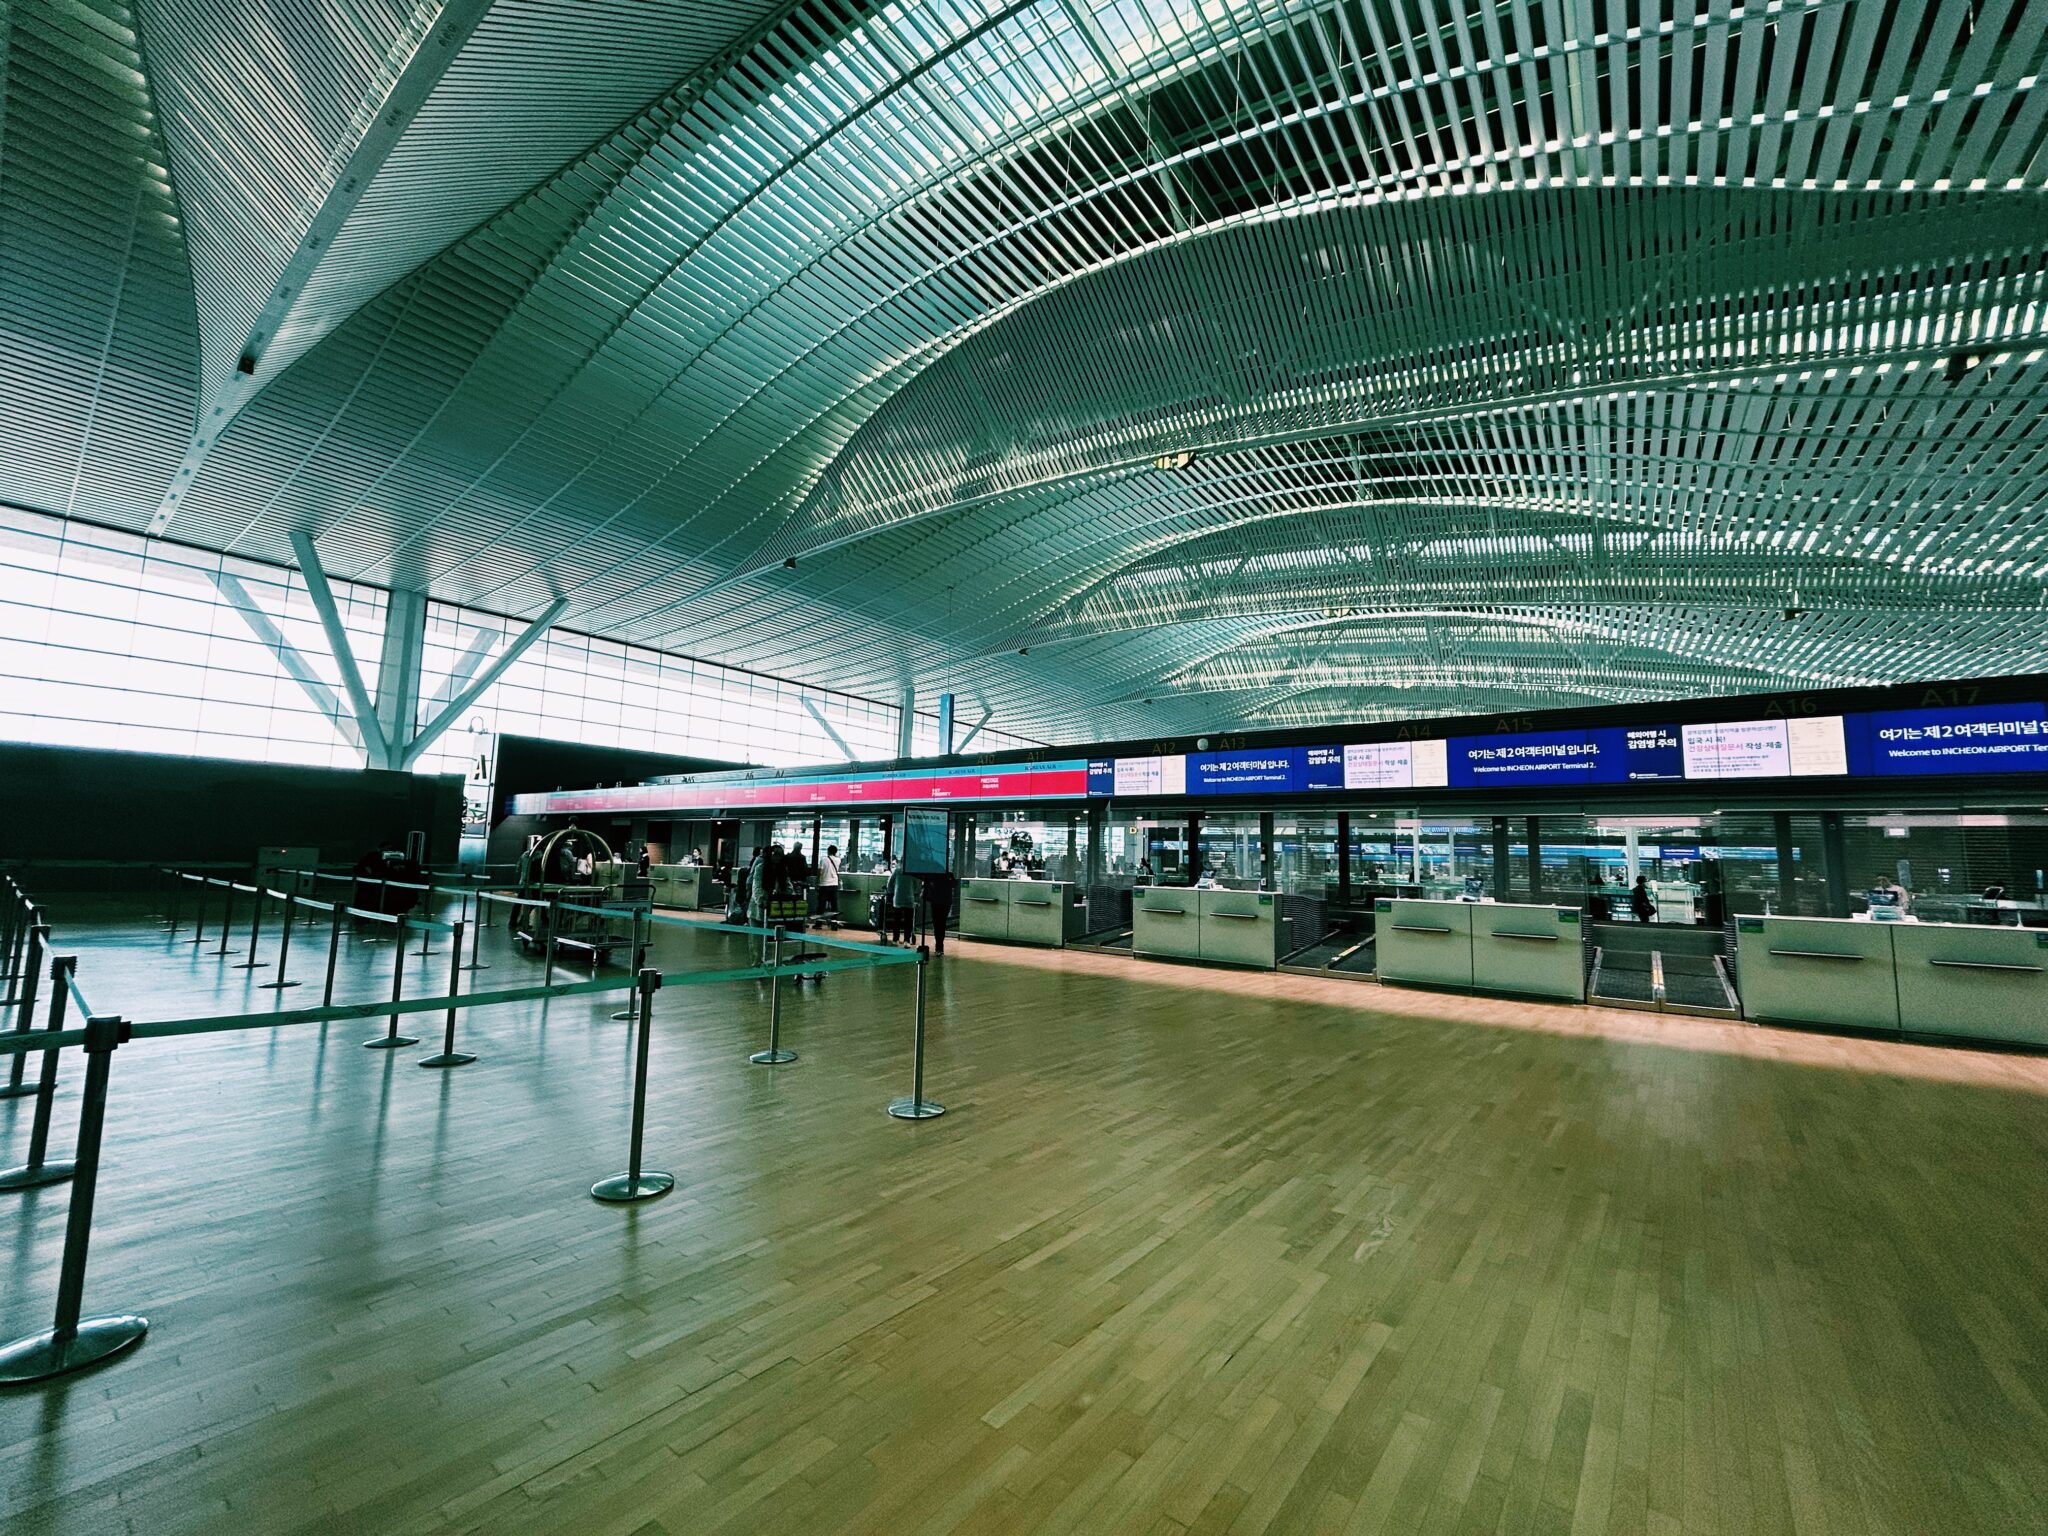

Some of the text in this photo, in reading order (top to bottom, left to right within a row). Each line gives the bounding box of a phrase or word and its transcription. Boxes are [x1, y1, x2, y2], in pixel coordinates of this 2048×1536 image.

[1920, 686, 1980, 706] A17
[1763, 696, 1817, 717] A16
[1396, 723, 1432, 739] A14
[1495, 717, 1534, 733] A15
[1879, 727, 1923, 741] 여기는
[1924, 725, 1940, 739] 제
[1942, 726, 1953, 738] 2
[1954, 720, 2039, 738] 여객터미널
[1658, 729, 1667, 738] 시
[1219, 737, 1246, 750] A13
[1656, 738, 1677, 749] 주의
[1705, 736, 1713, 745] 시
[1151, 742, 1176, 754] A12
[1468, 744, 1600, 759] 여기는 제 2 여객터미널 입니다.
[1889, 749, 1930, 758] Welcome
[1942, 746, 1987, 755] INCHEON
[1987, 744, 2030, 753] AIRPORT
[977, 754, 996, 765] A10
[1027, 751, 1045, 761] A11
[474, 754, 487, 780] A
[1200, 760, 1290, 772] 여기는 제 2 여객터미널 입니다.
[1507, 764, 1535, 772] INCHEON
[1535, 763, 1561, 771] AIRPORT
